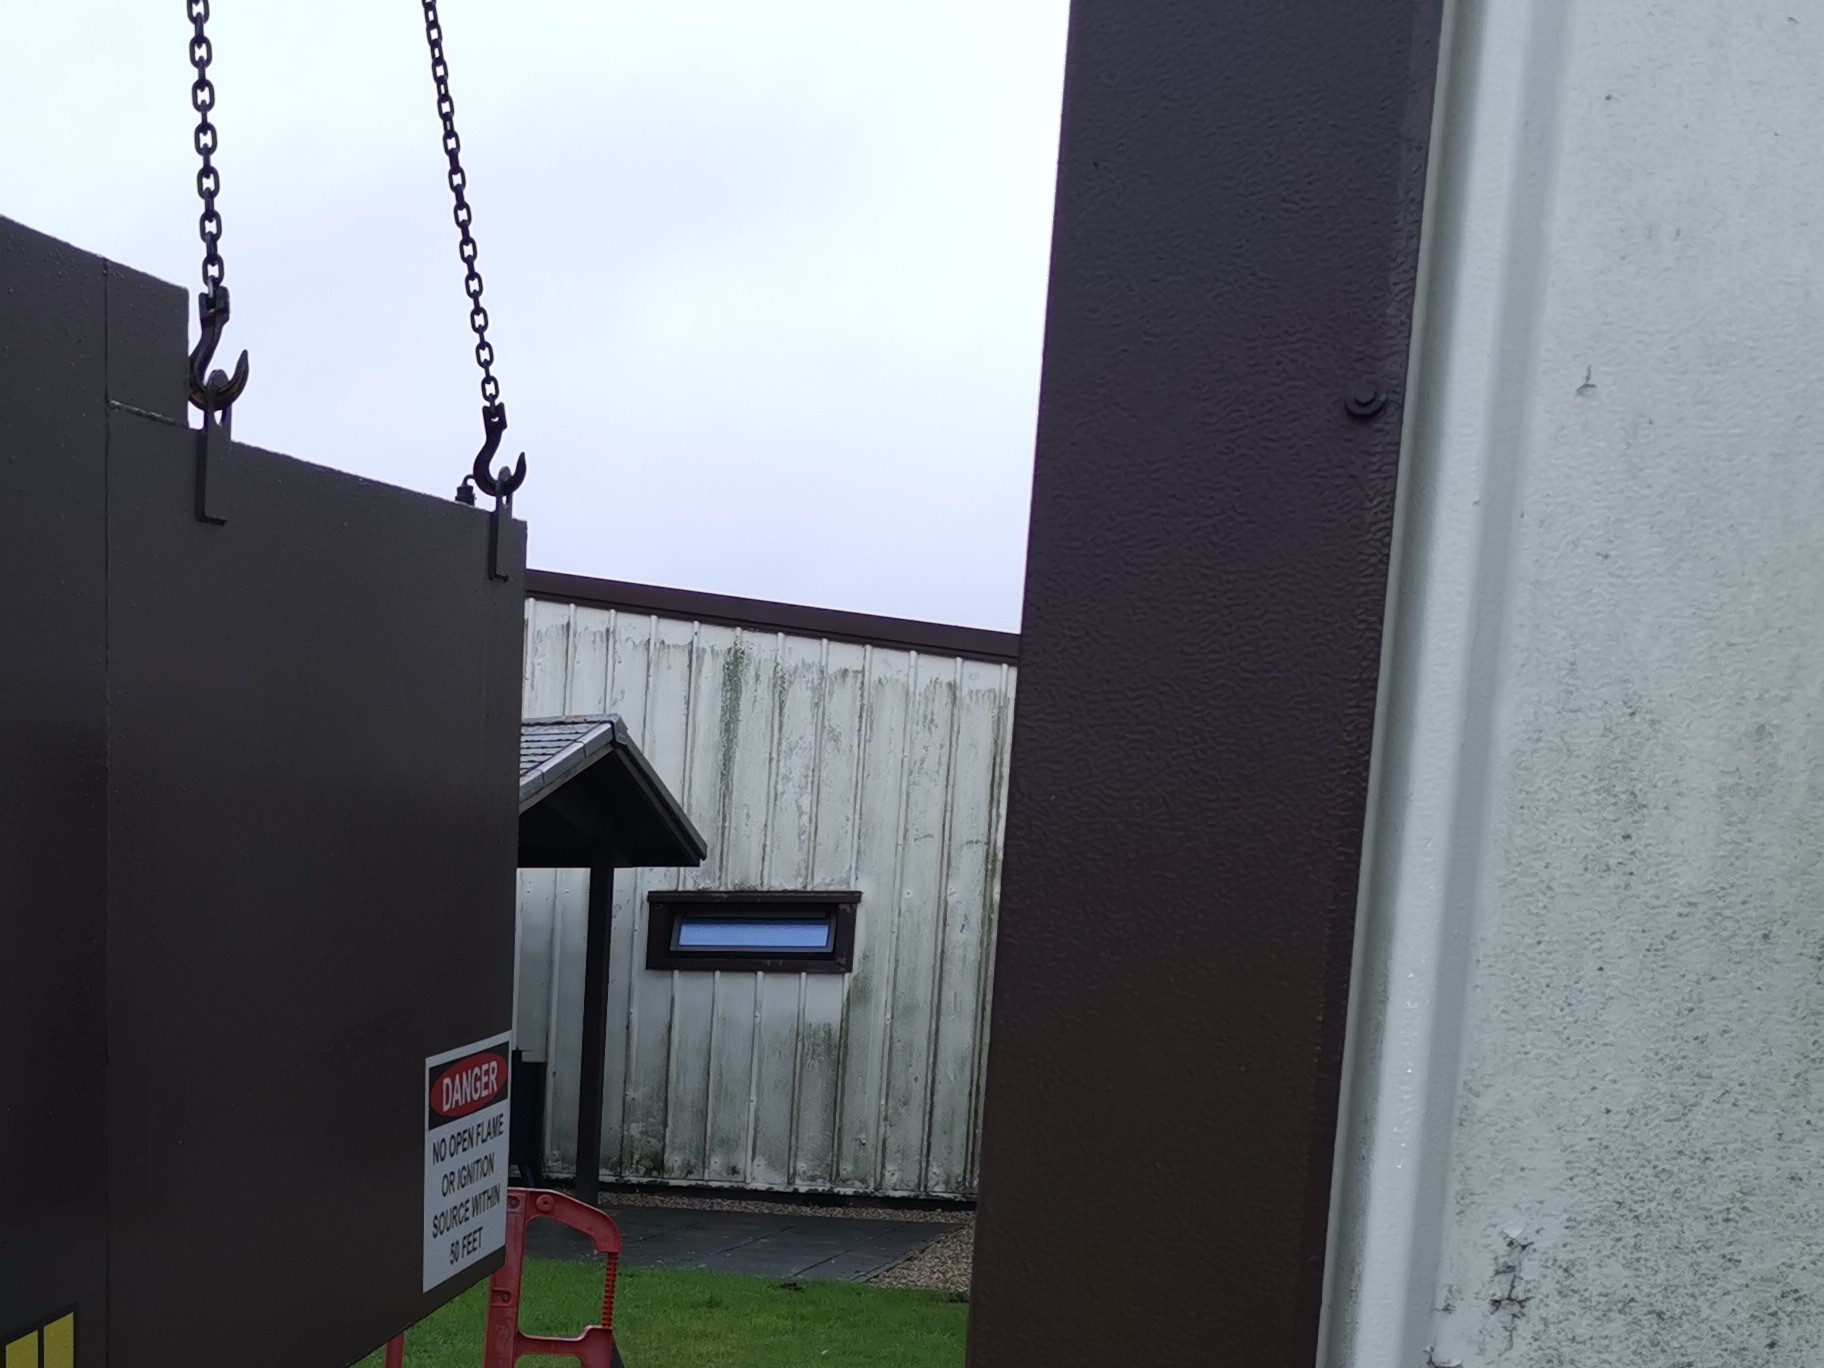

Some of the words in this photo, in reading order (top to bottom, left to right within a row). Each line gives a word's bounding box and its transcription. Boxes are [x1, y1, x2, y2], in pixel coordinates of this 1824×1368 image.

[442, 1060, 498, 1112] DANGER
[432, 1137, 447, 1166] NO
[449, 1125, 475, 1158] OPEN
[476, 1113, 504, 1146] FLAME
[442, 1170, 456, 1198] OR
[457, 1151, 495, 1191] IGNITION
[432, 1198, 470, 1239] SOURCE
[471, 1183, 501, 1218] WITHIN
[450, 1239, 460, 1265] 50
[461, 1225, 484, 1259] FEET
